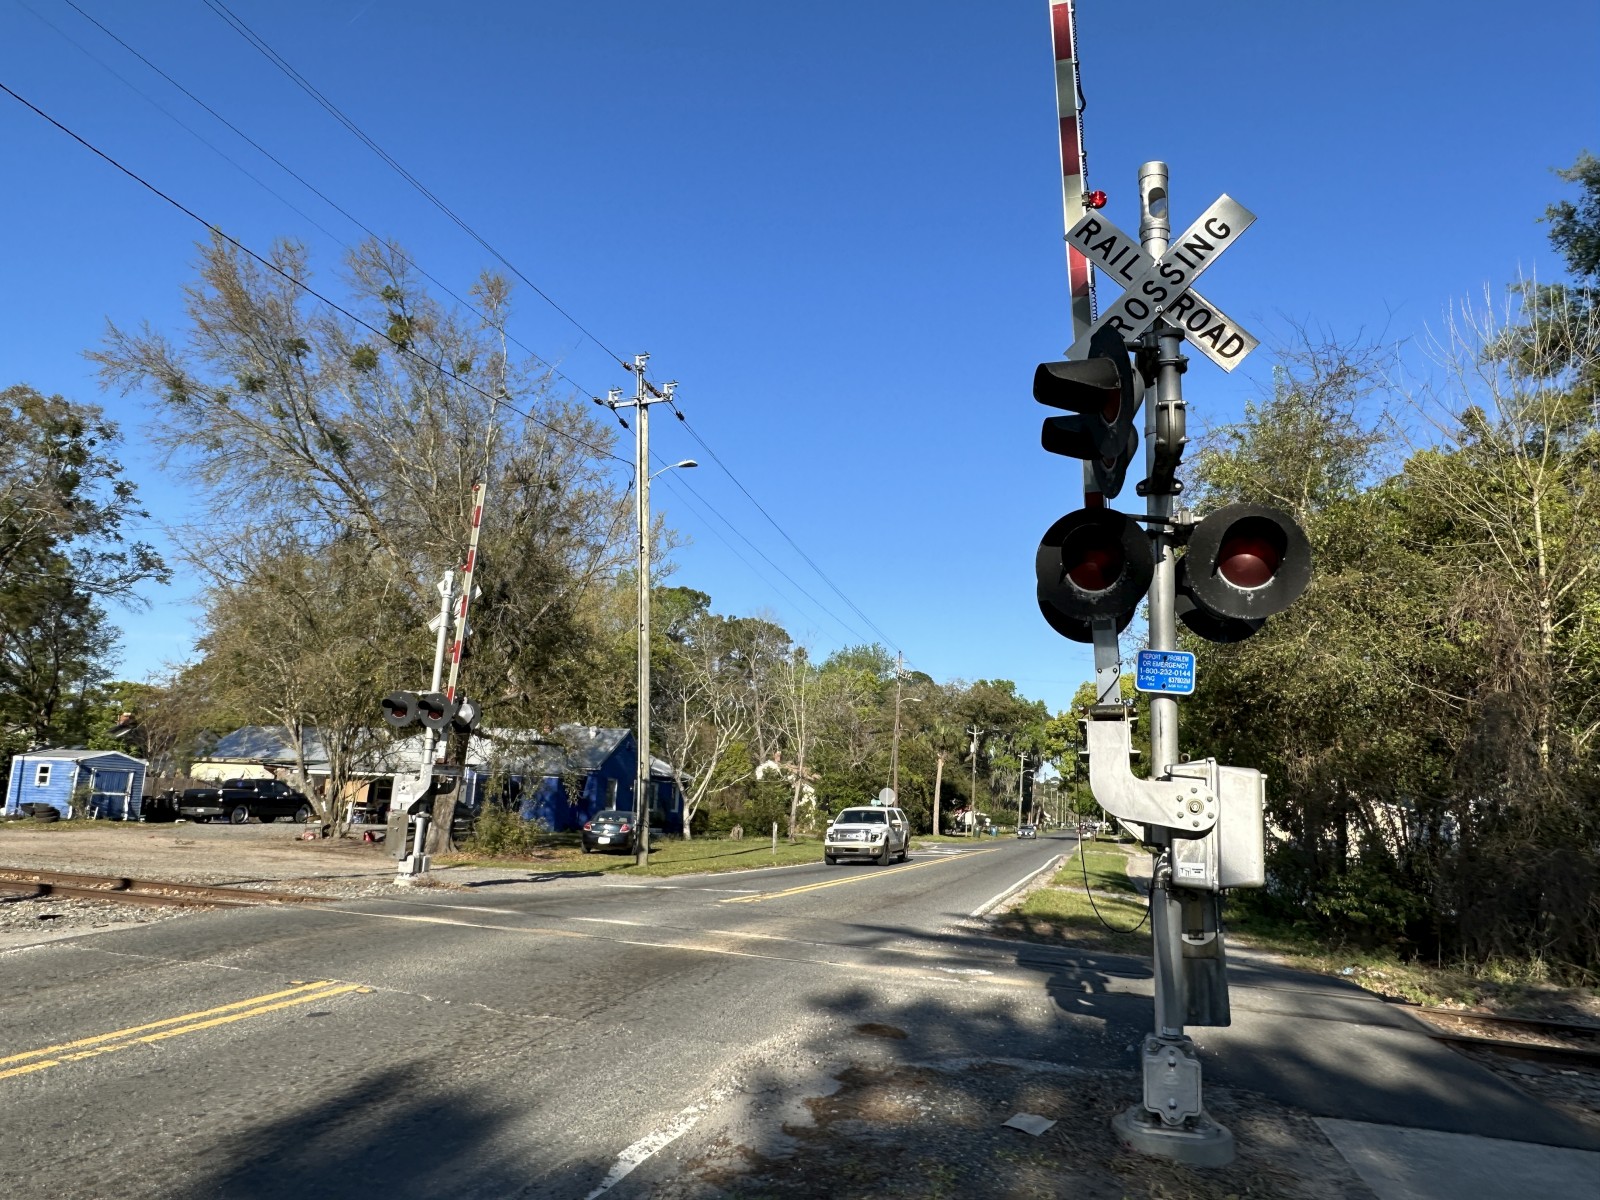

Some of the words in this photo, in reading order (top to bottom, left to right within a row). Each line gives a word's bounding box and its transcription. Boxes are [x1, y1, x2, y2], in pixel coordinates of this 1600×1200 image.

[1074, 218, 1141, 282] RAIL
[1167, 293, 1245, 359] ROAD
[1107, 217, 1231, 339] ROSSING
[1140, 668, 1191, 676] 1-800-232-0144
[1152, 661, 1189, 669] EMERGENCY
